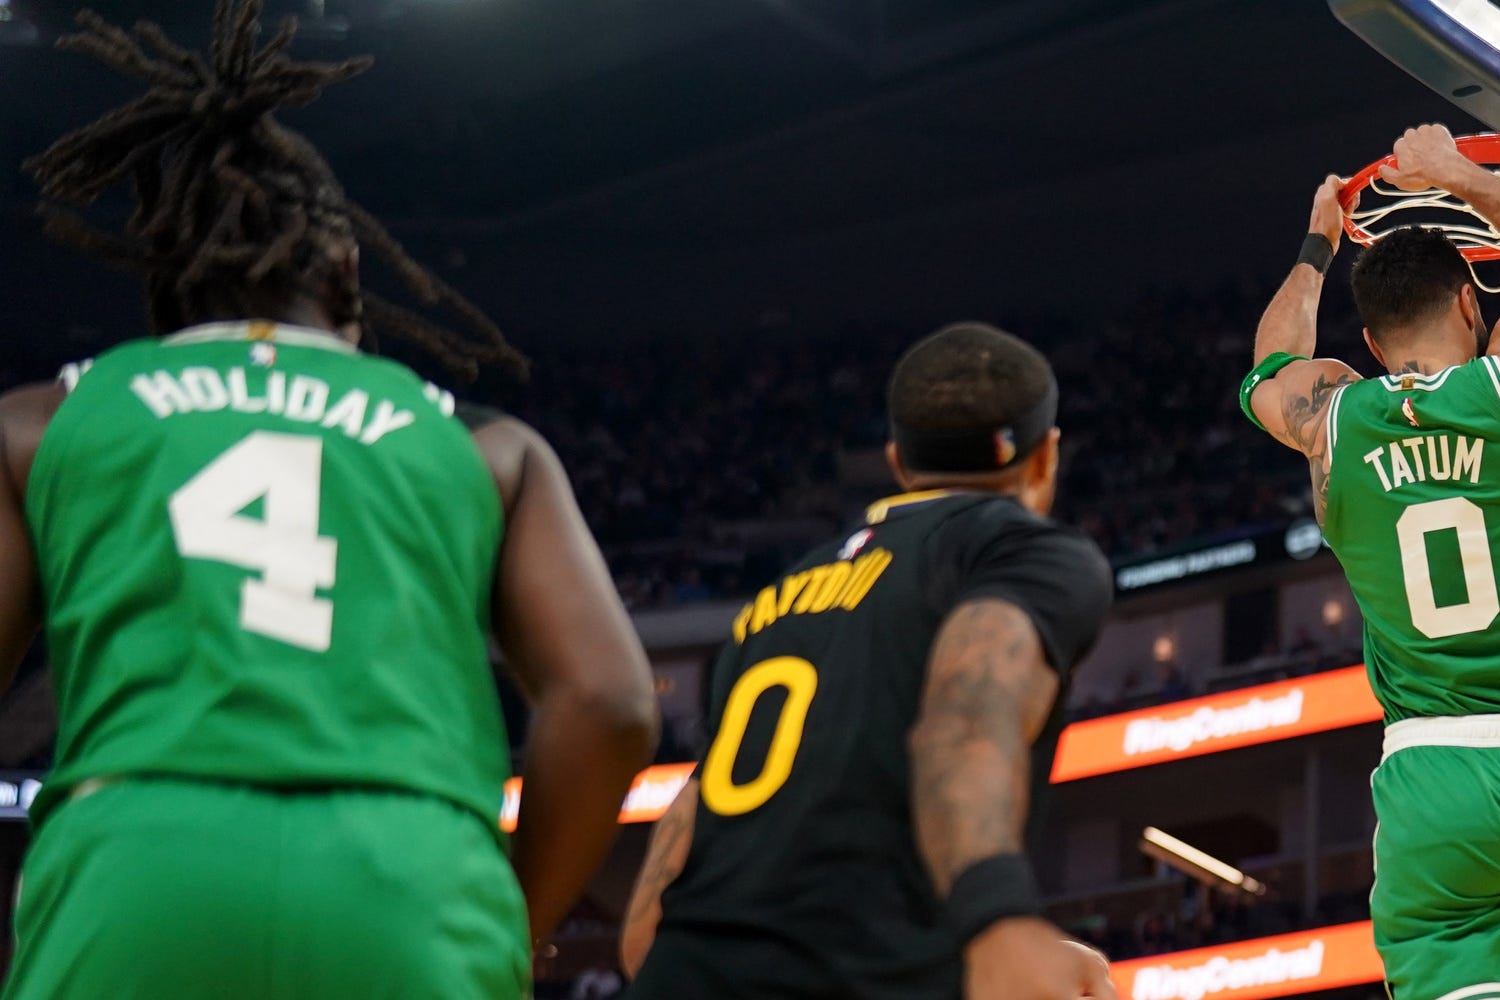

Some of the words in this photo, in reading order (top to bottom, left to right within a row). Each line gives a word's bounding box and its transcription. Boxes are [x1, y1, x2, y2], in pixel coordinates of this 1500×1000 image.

[130, 366, 414, 445] HOLIDAY
[1364, 436, 1485, 493] TATUM
[168, 430, 338, 653] 4
[1396, 496, 1500, 639] 0
[700, 656, 818, 817] 0
[1125, 690, 1303, 754] RingCentral
